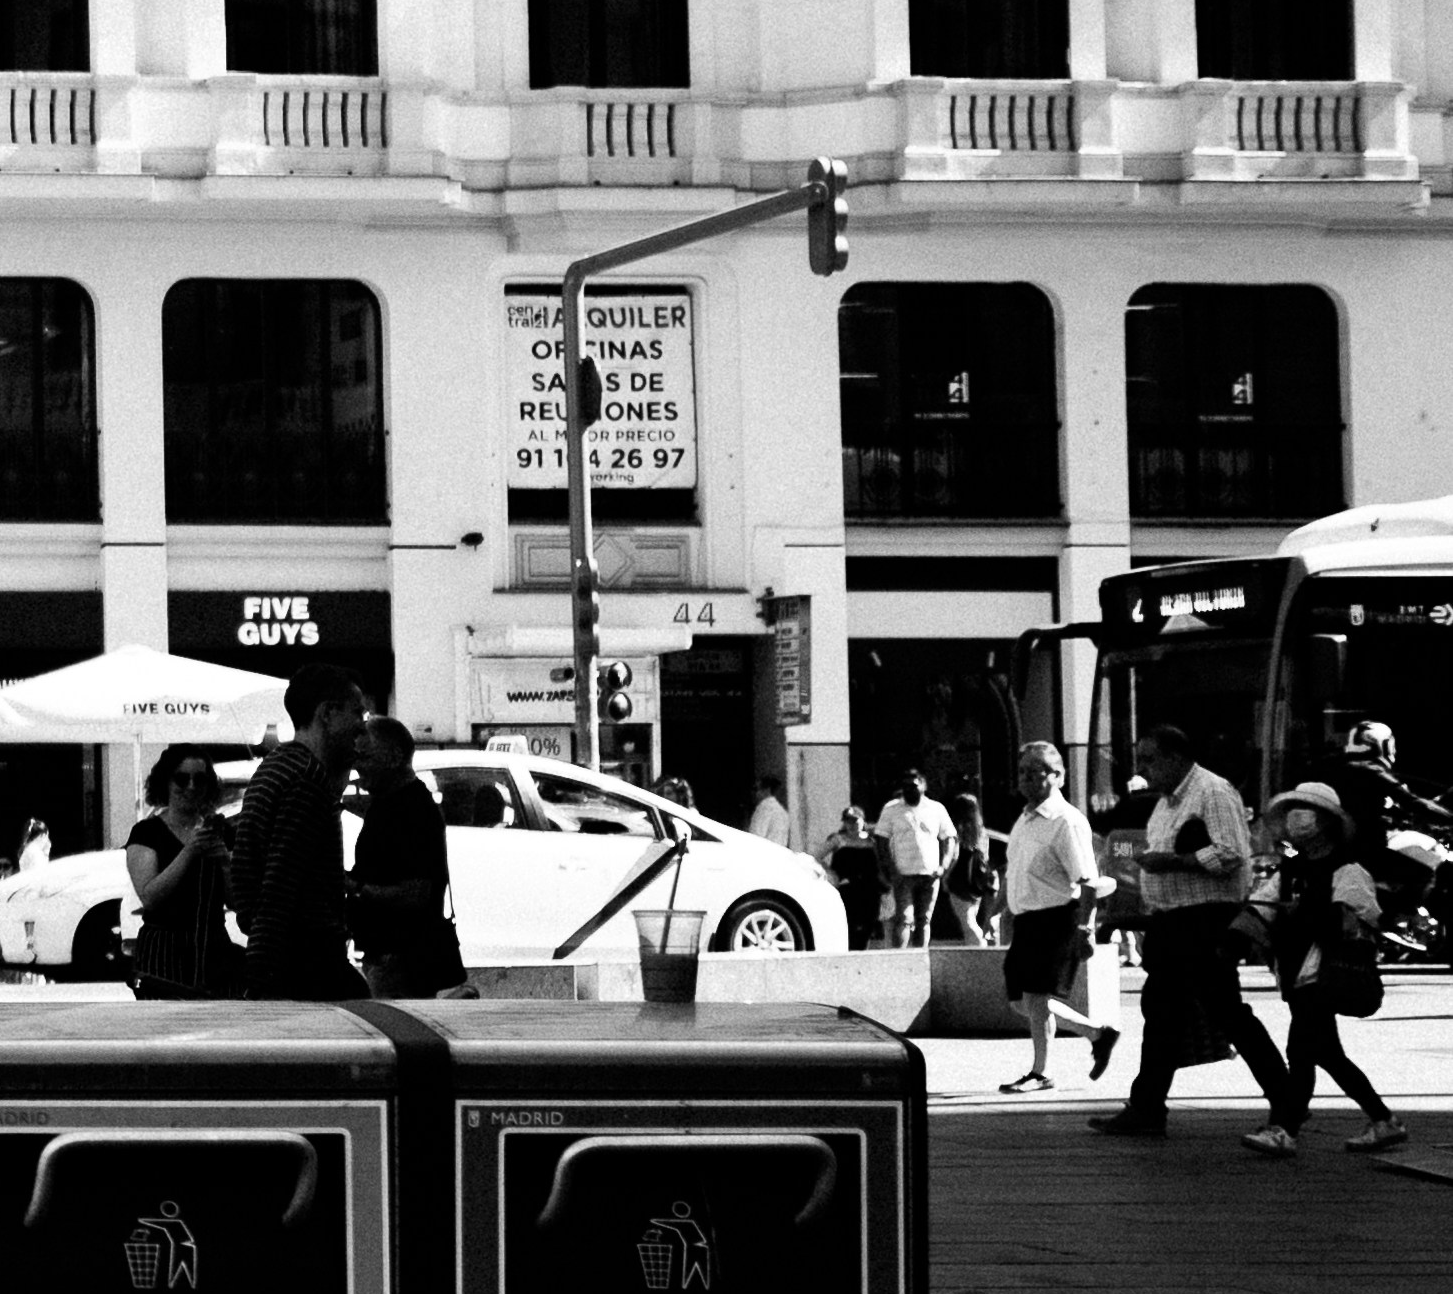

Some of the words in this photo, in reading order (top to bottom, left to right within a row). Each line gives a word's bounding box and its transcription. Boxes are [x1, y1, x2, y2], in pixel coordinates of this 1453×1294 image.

[552, 307, 686, 329] AQUILER
[531, 340, 663, 360] OFCINAS
[531, 373, 620, 392] SAS
[631, 373, 664, 392] DE
[528, 430, 548, 442] AL
[616, 430, 675, 442] PRECIO
[516, 448, 543, 469] 91
[611, 449, 643, 469] 26
[652, 448, 685, 469] 97
[243, 596, 310, 620] FIVE
[237, 620, 320, 646] GUYS
[123, 702, 159, 716] FIVE
[165, 702, 210, 716] GUYS
[491, 1110, 564, 1125] MADRID
